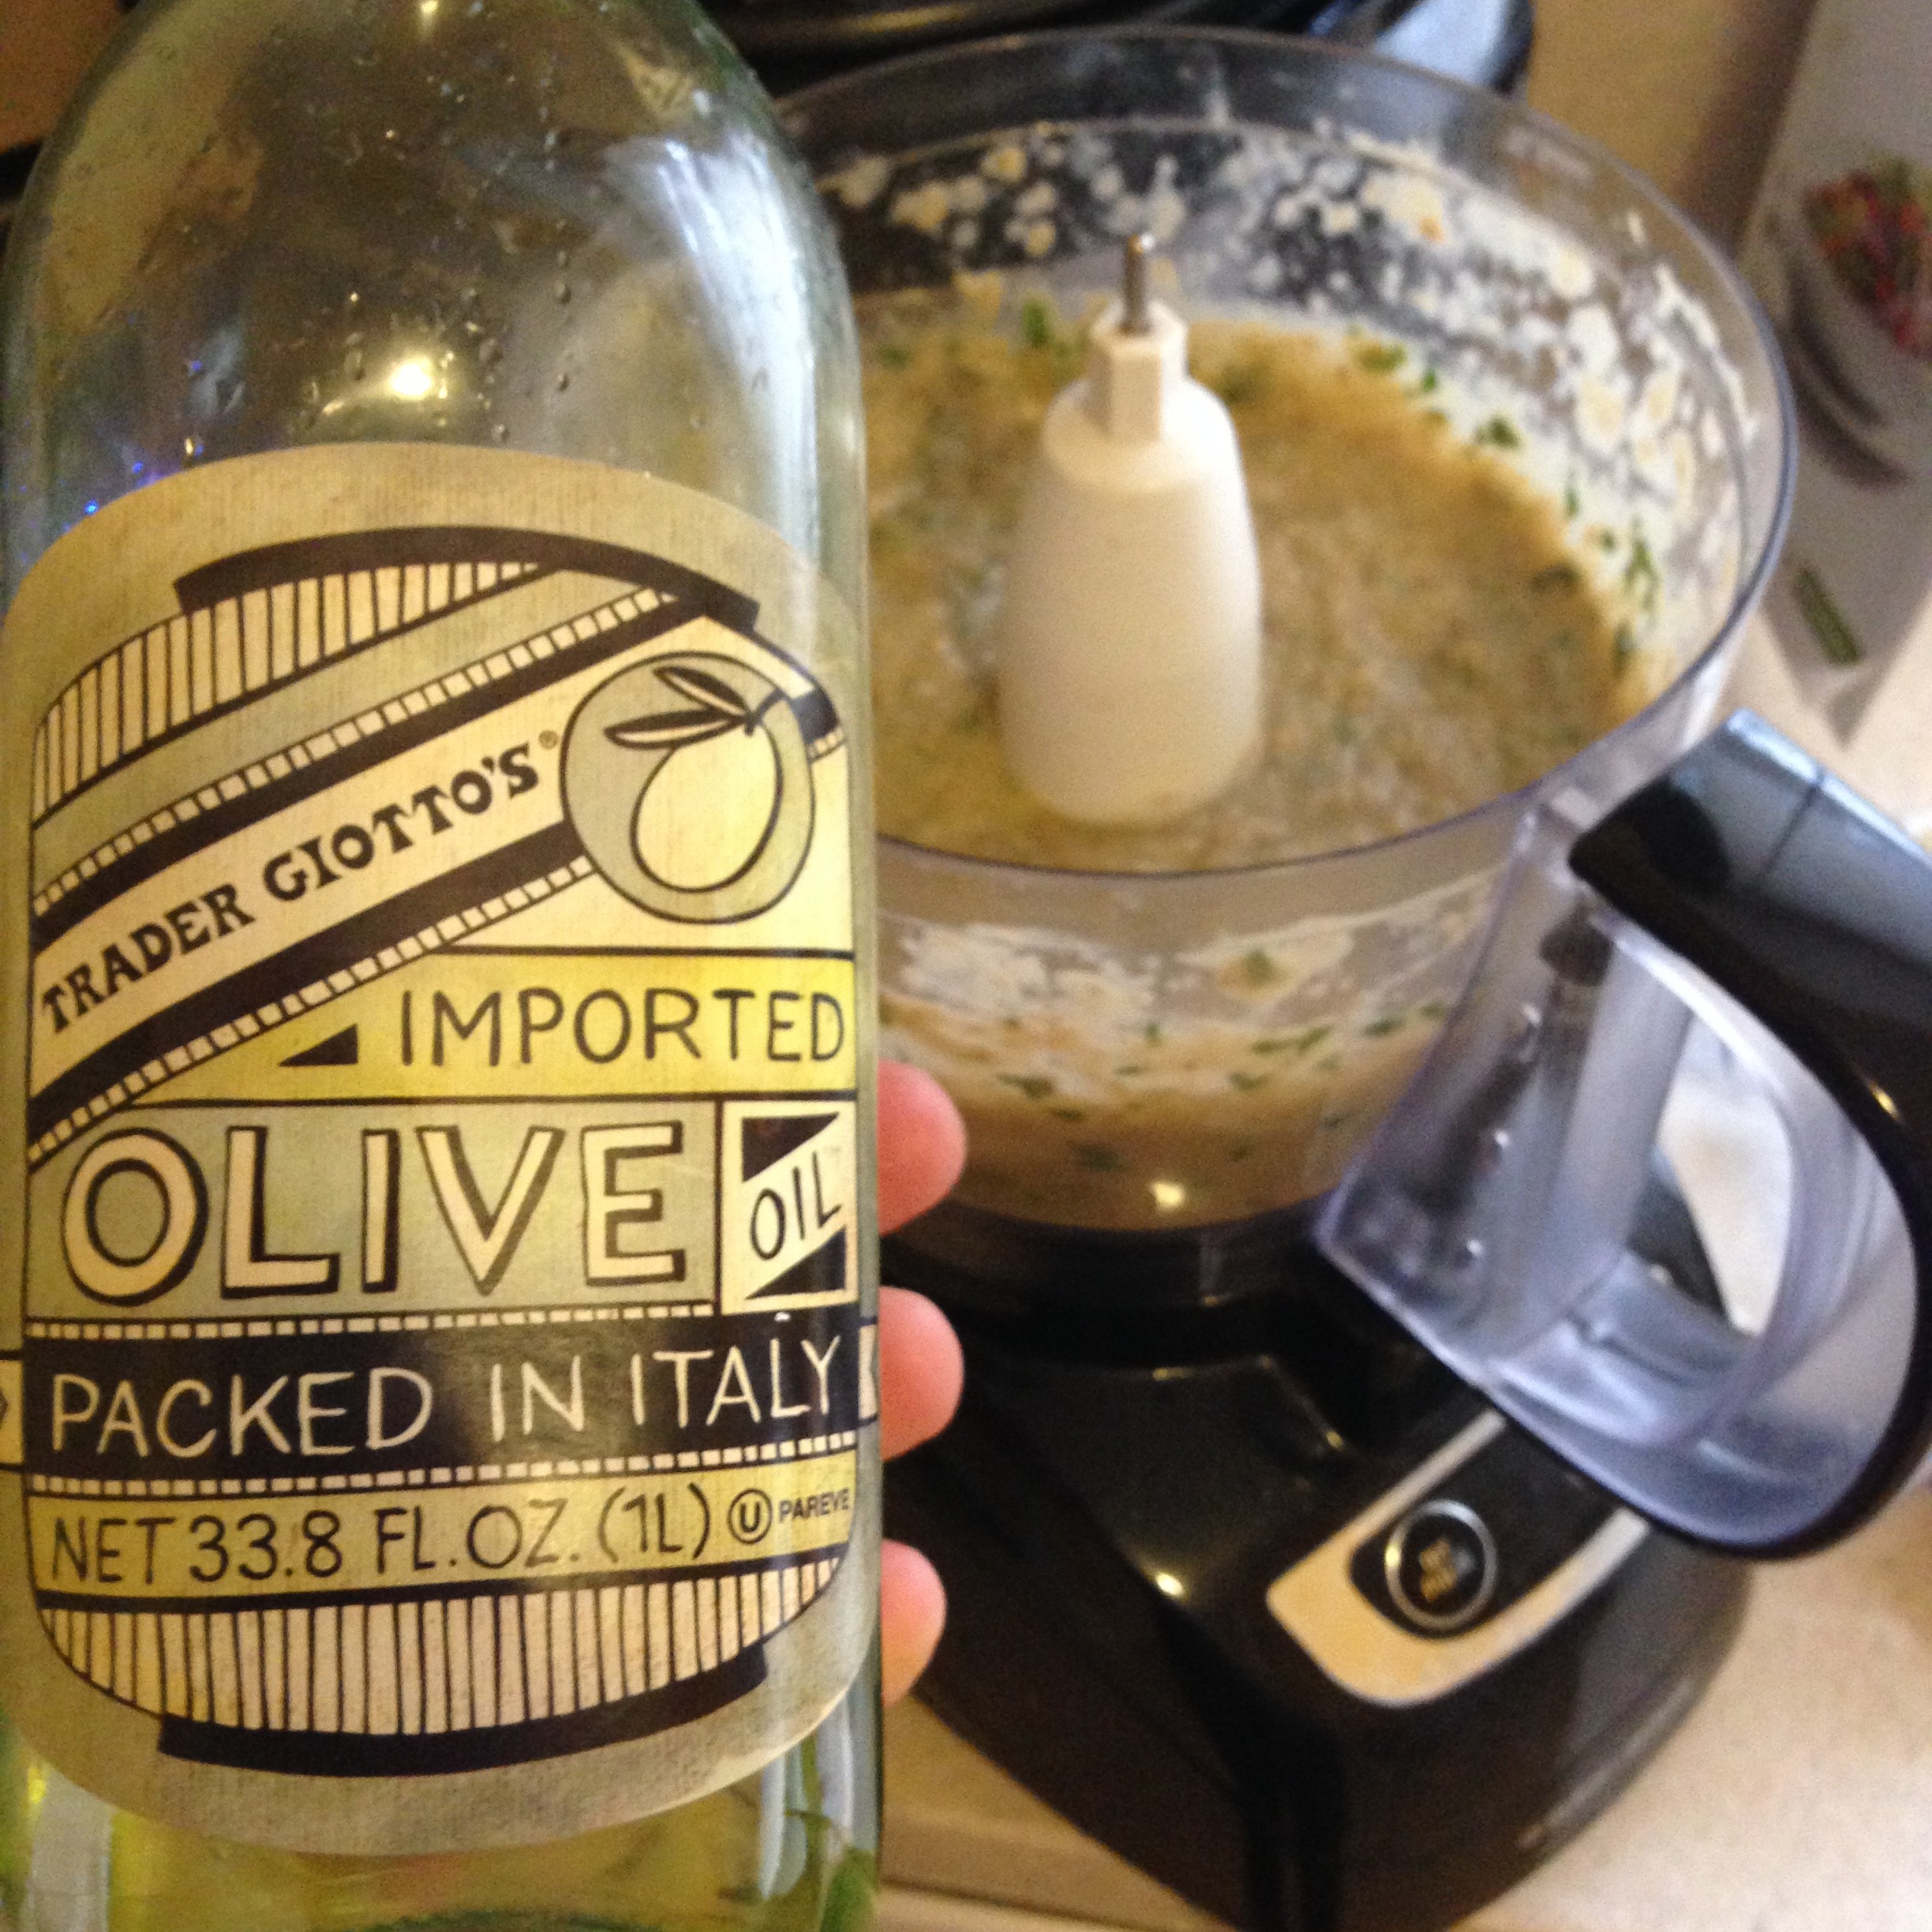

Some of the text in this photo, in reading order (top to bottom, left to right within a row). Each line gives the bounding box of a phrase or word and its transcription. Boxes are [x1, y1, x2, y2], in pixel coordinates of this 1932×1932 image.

[42, 743, 539, 1034] TRADER GIOTTO'S
[402, 987, 844, 1066] IMPORTED
[61, 1119, 686, 1308] OLIVE
[750, 1151, 842, 1260] OIL
[52, 1336, 841, 1458] PACKED IN ITALY
[52, 1516, 175, 1585] NET
[188, 1509, 343, 1582] 33.8
[597, 1481, 711, 1563] (1L)
[777, 1486, 851, 1523] PAREVE
